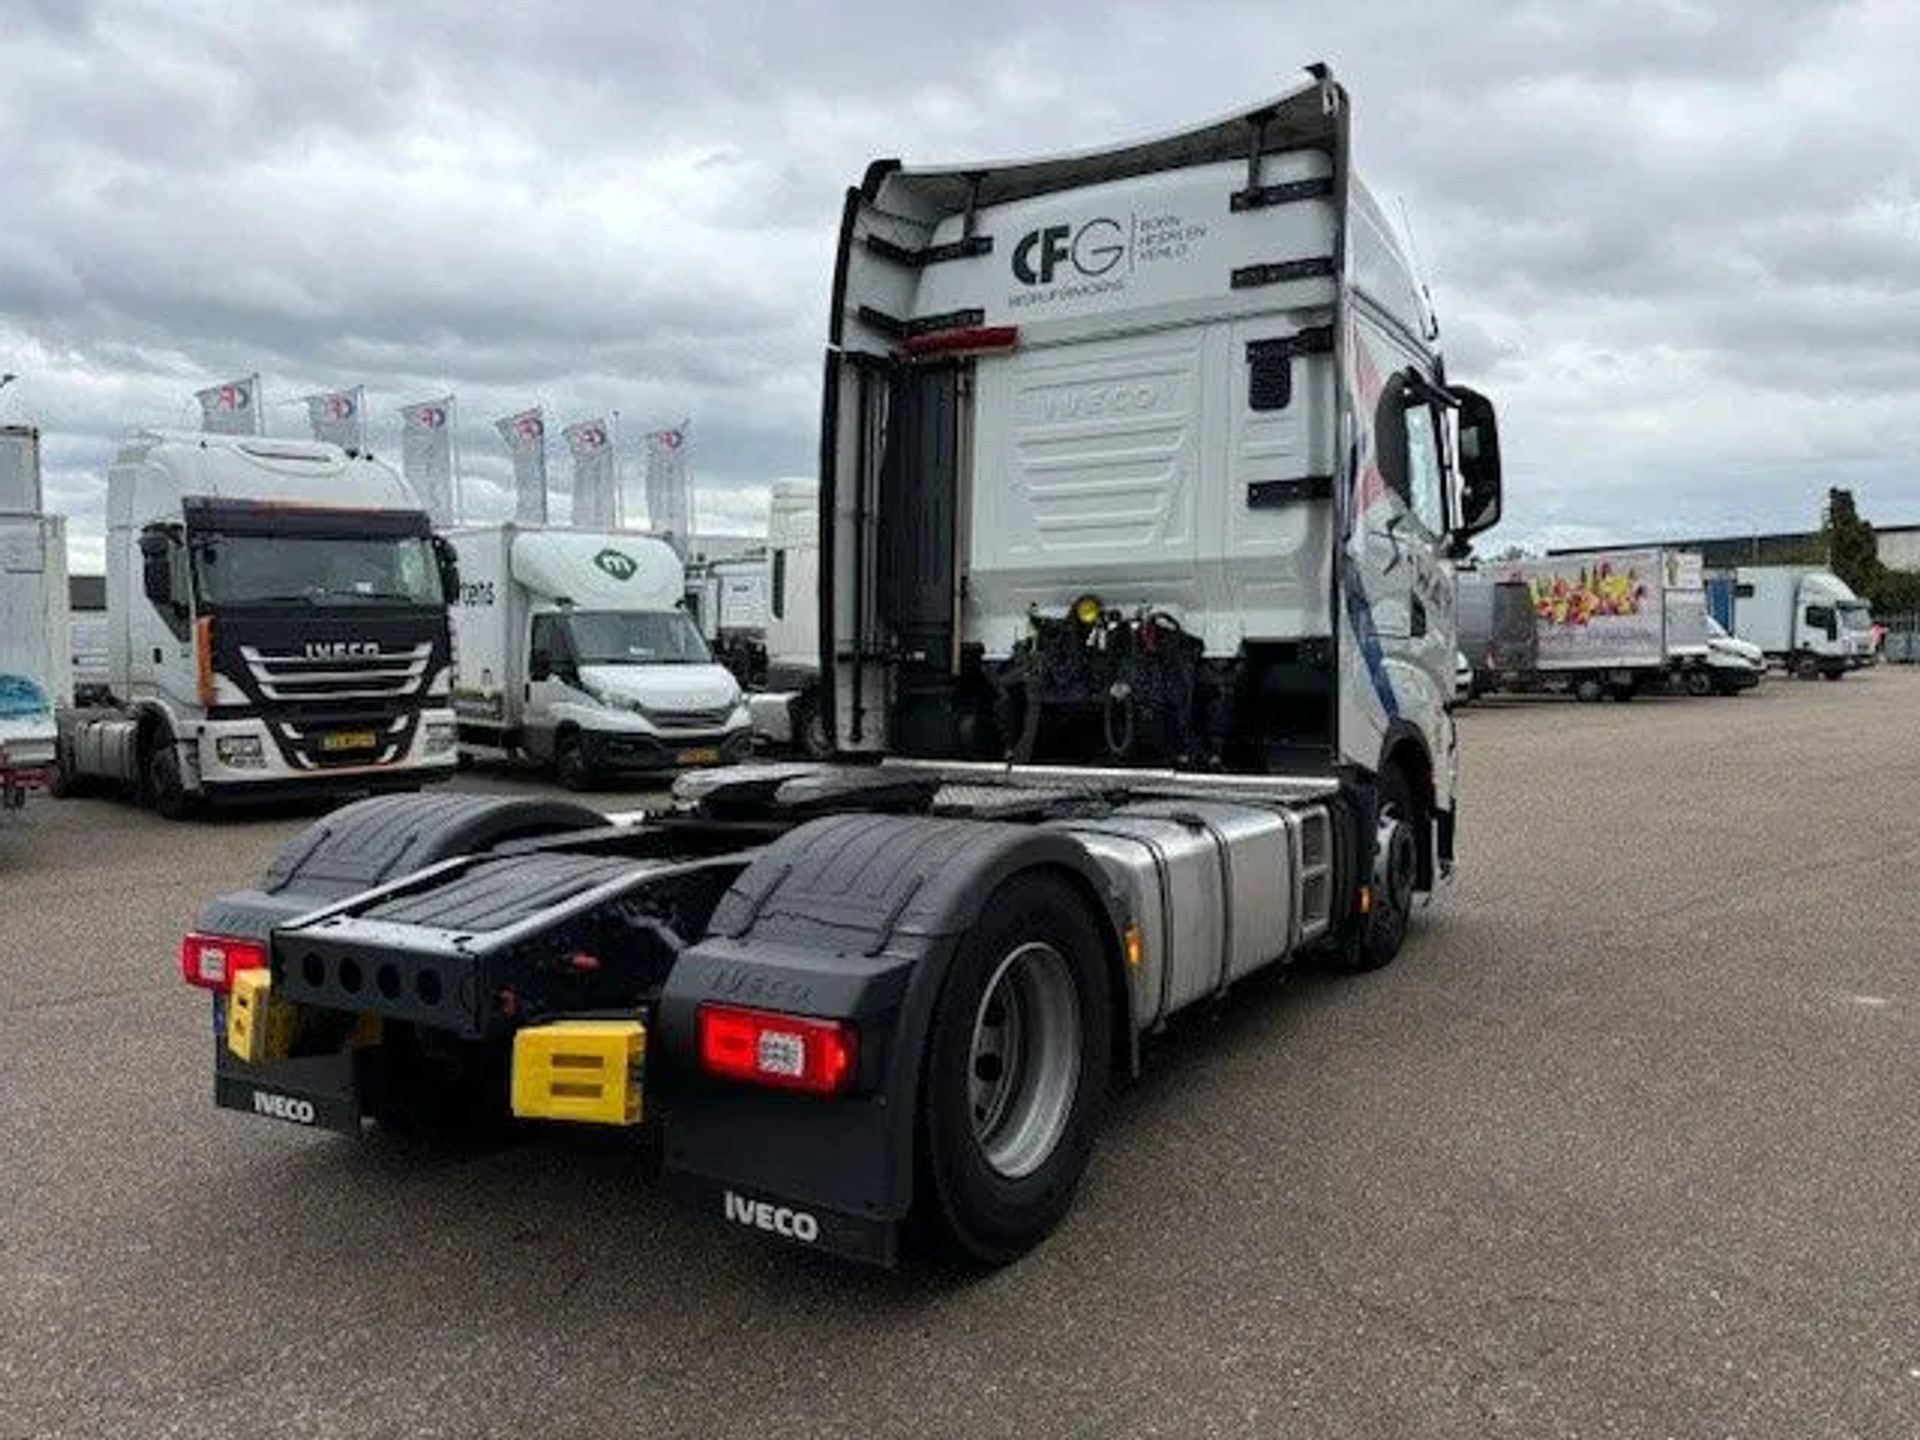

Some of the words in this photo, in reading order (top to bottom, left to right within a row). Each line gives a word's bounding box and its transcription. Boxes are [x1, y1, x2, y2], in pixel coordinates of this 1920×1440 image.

[1012, 218, 1123, 285] CFG
[305, 641, 380, 661] IVECO
[254, 1091, 315, 1123] IVECO
[725, 1191, 819, 1242] IVECO
